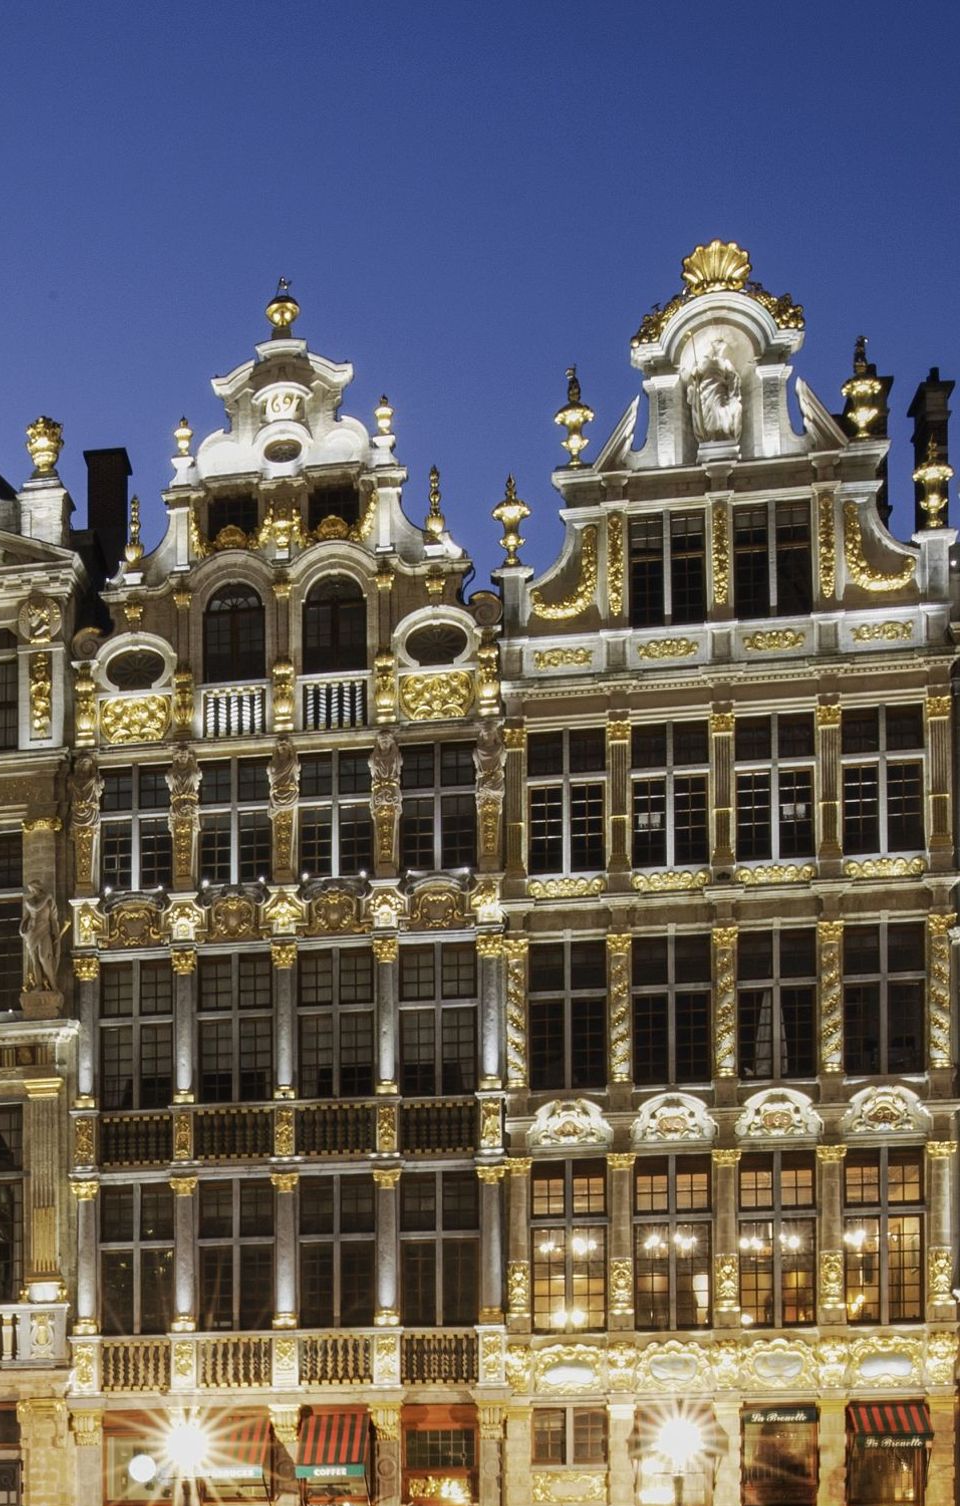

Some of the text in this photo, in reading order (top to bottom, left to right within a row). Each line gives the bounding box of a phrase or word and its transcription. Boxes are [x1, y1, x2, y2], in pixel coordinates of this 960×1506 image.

[261, 393, 303, 415] 1697
[750, 1412, 765, 1422] La
[865, 1436, 879, 1448] La
[313, 1467, 347, 1477] COFFEE
